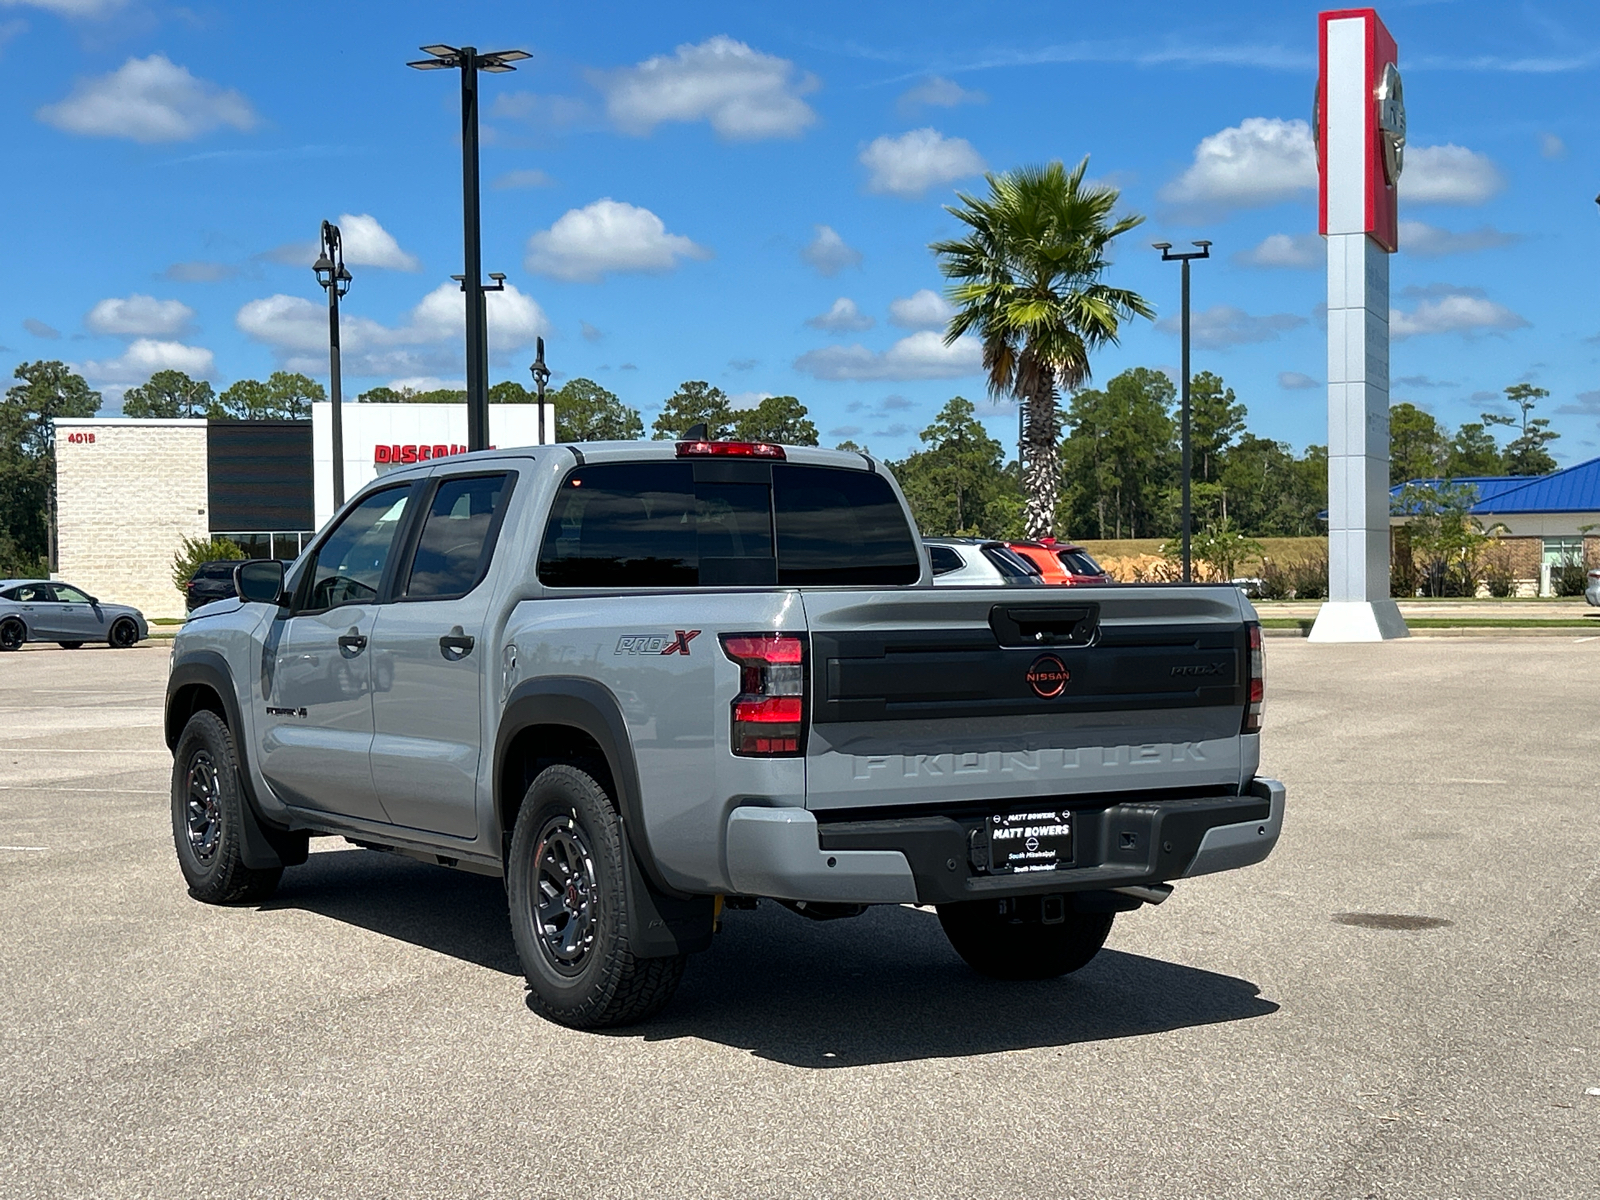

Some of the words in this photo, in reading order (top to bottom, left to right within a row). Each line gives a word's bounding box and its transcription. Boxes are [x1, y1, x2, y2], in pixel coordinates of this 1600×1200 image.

[67, 432, 96, 444] 4018
[1026, 672, 1070, 682] NISSAN
[993, 827, 1023, 839] MATT
[1024, 825, 1069, 837] BOWERS
